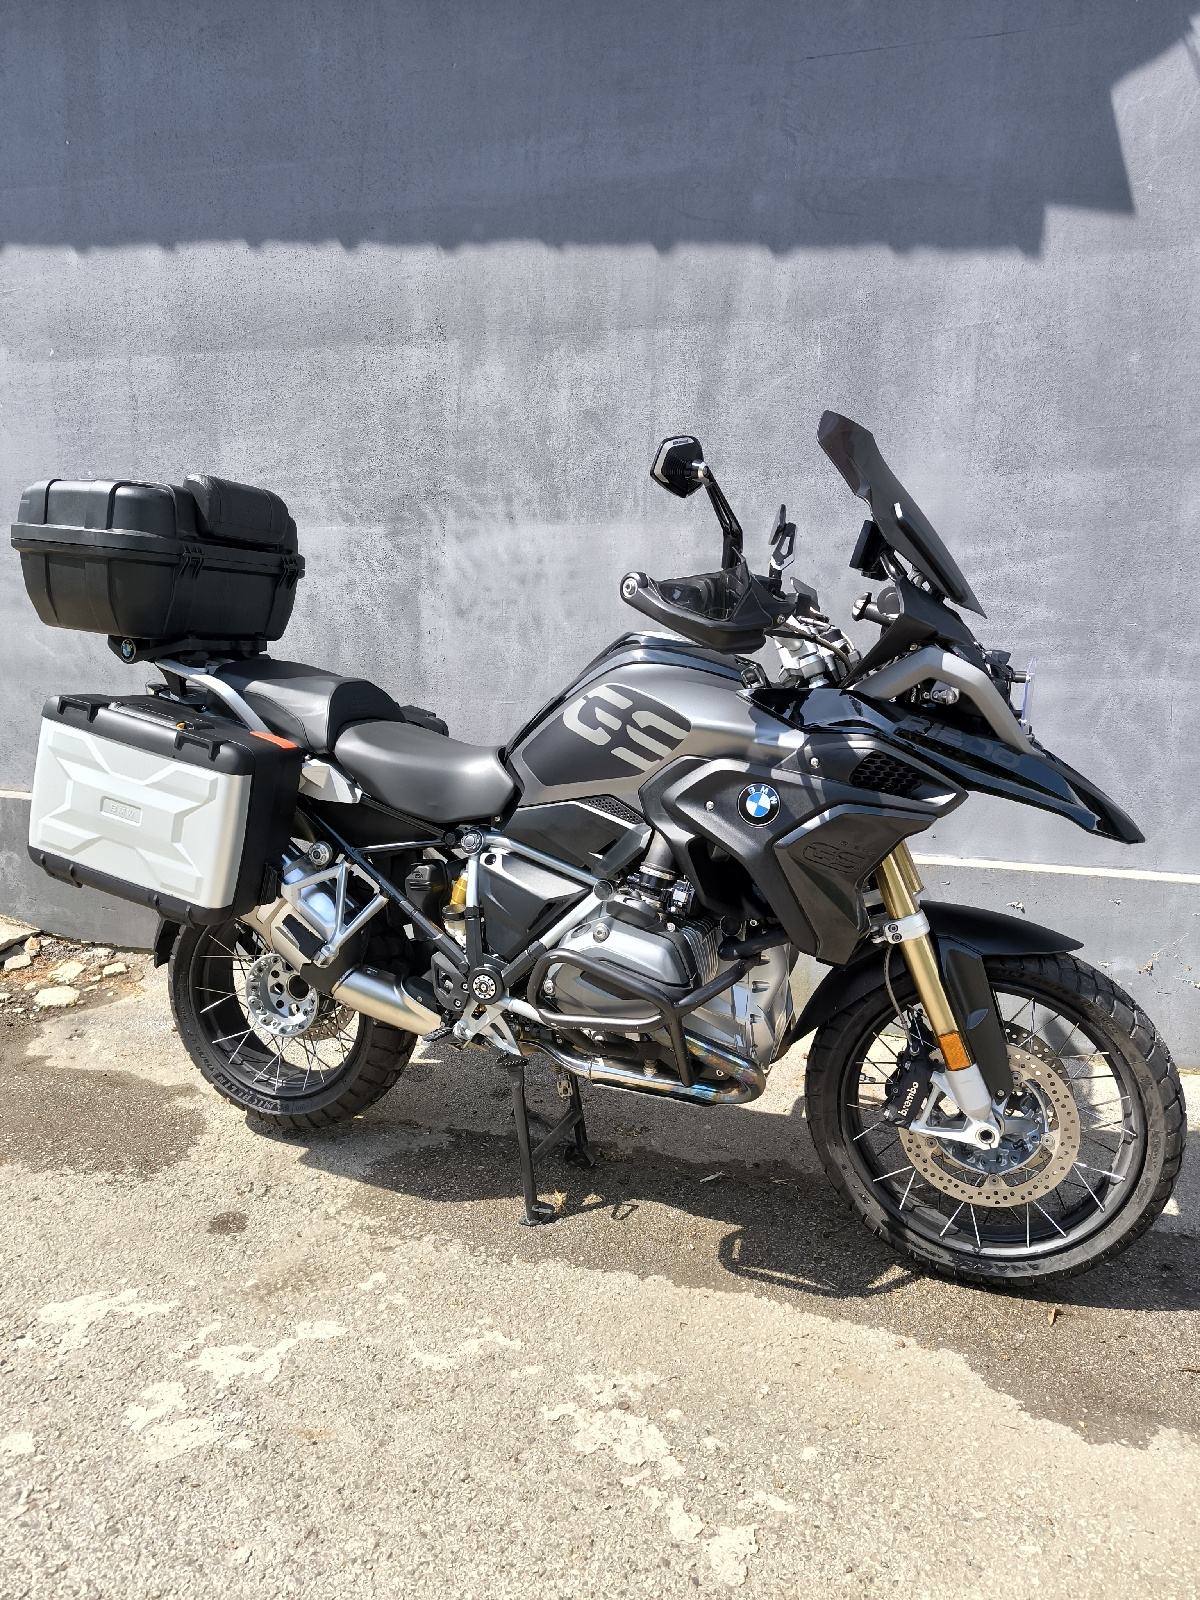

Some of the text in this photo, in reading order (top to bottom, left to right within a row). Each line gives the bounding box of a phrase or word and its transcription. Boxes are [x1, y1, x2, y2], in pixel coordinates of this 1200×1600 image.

[562, 685, 690, 772] GS
[748, 786, 778, 804] BMW
[898, 1081, 919, 1117] brembo
